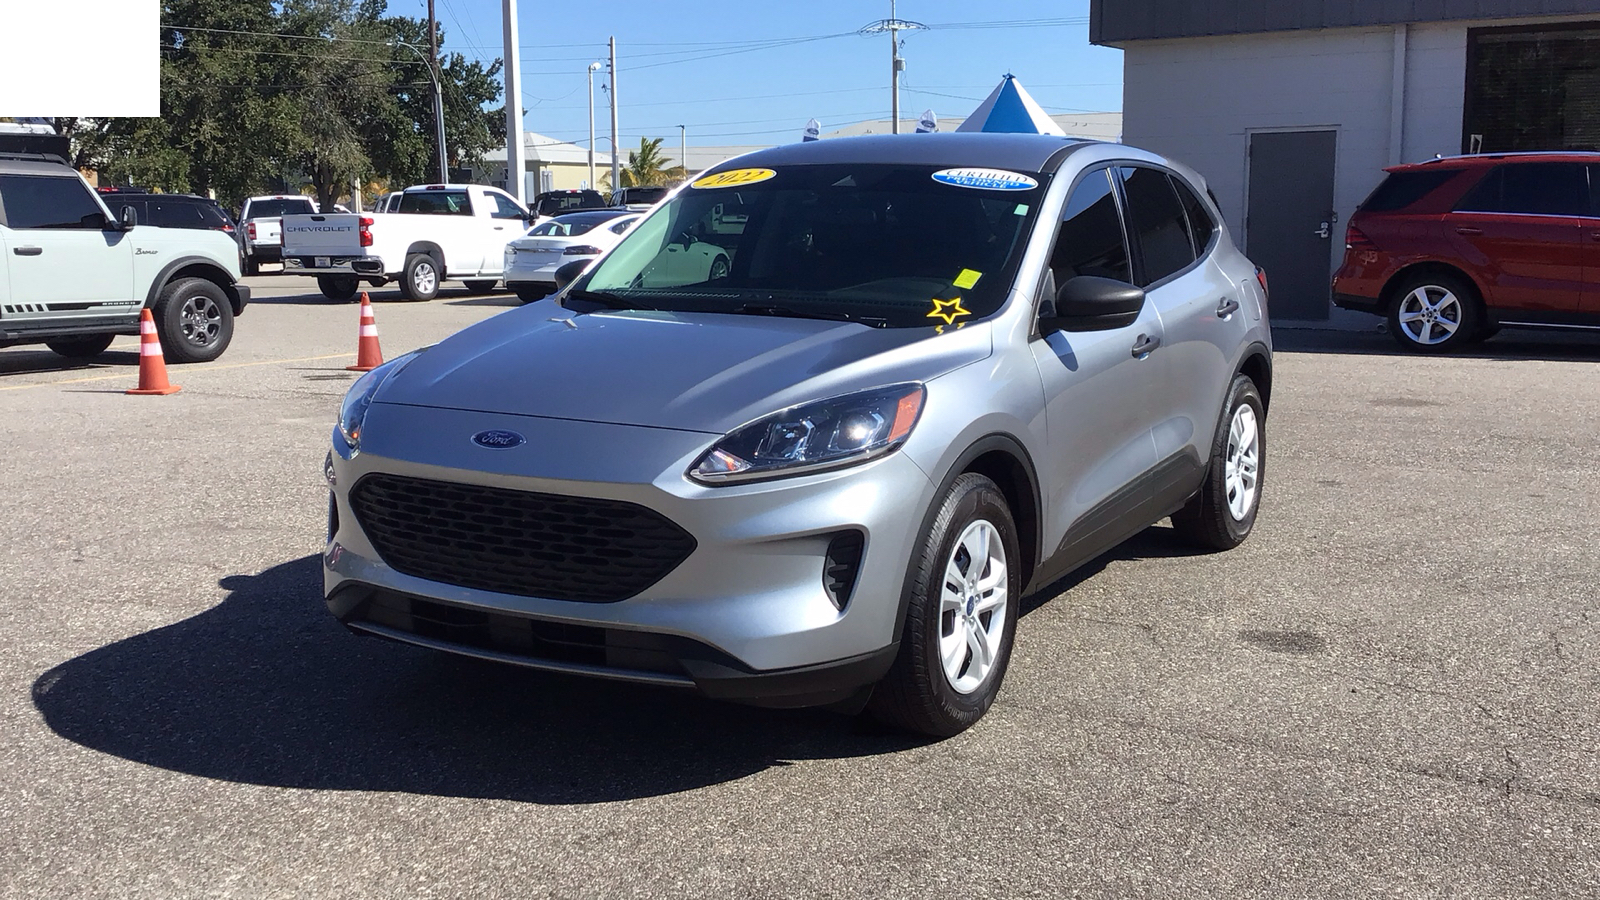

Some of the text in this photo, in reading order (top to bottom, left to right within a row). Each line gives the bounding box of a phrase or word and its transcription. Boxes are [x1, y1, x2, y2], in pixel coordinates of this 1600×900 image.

[946, 170, 1028, 182] CERTIFIED
[956, 180, 1007, 189] VEHICLE
[135, 247, 158, 255] Bronco
[482, 432, 513, 445] Ford
